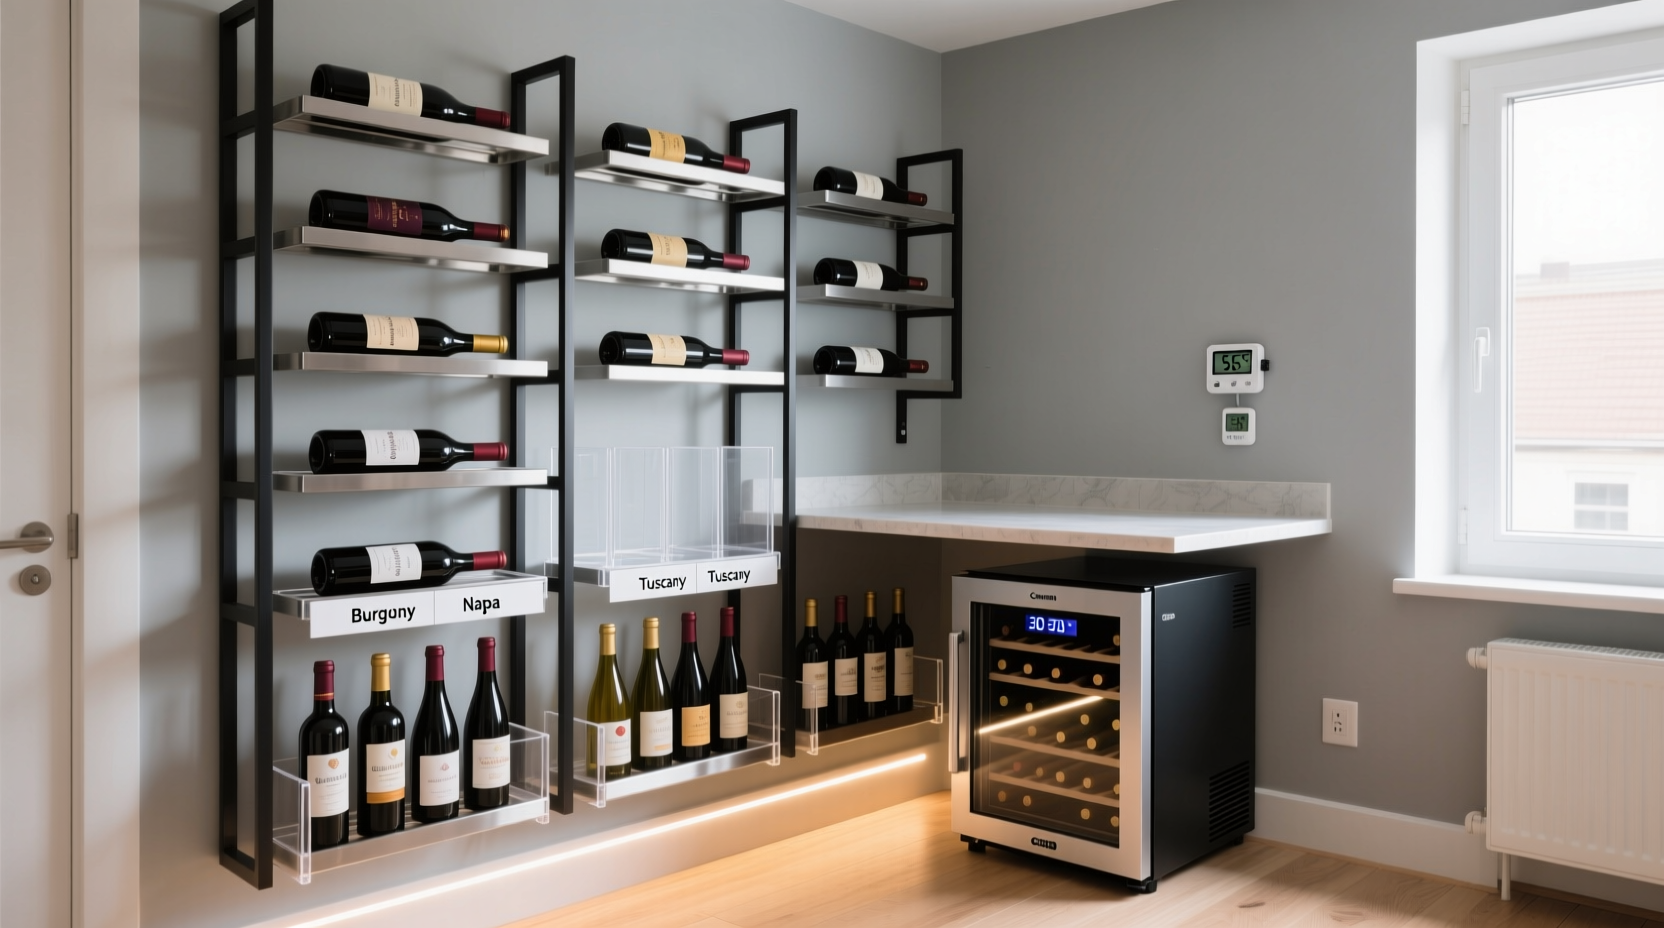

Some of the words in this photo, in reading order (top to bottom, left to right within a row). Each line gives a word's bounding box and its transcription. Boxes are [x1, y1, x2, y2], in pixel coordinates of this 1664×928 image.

[638, 576, 687, 591] Tuscany
[705, 569, 751, 584] Tuscany
[462, 596, 501, 615] Napa
[351, 606, 416, 625] Burgony
